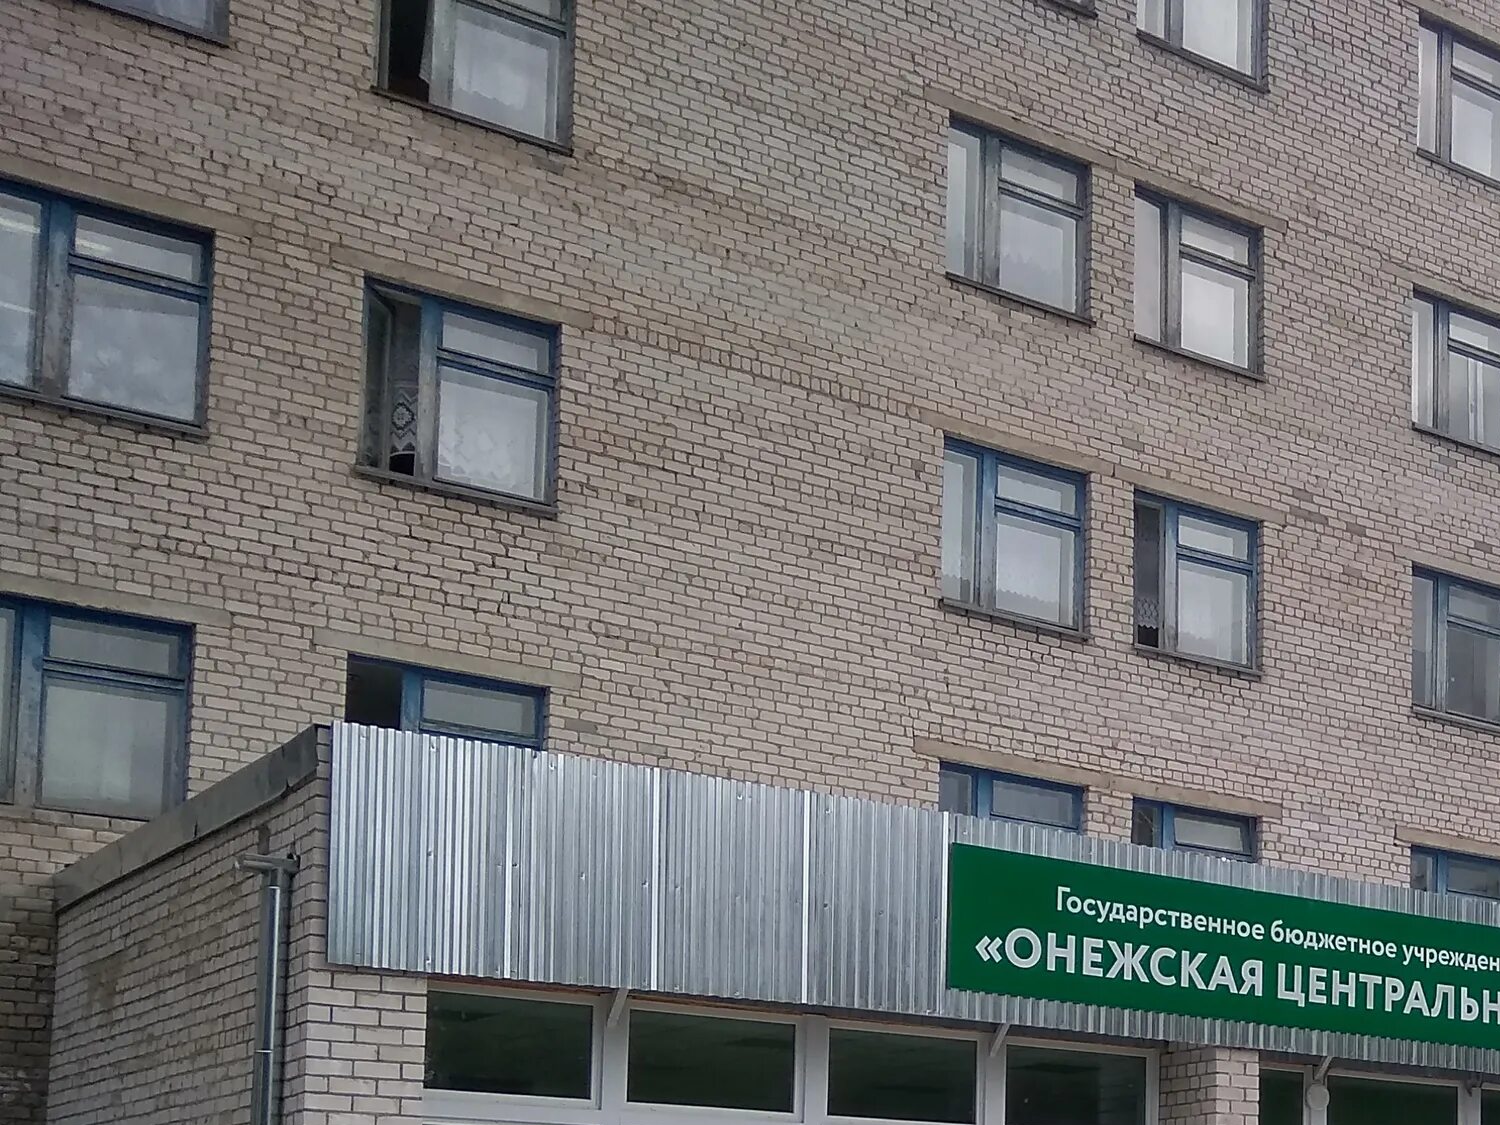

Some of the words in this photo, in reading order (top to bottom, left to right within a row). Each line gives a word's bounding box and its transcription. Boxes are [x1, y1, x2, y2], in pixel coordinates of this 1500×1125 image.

[1056, 885, 1265, 943] Государственное
[1270, 926, 1398, 958] бюджетное
[975, 927, 1264, 997] «ОНЕЖСКАЯ
